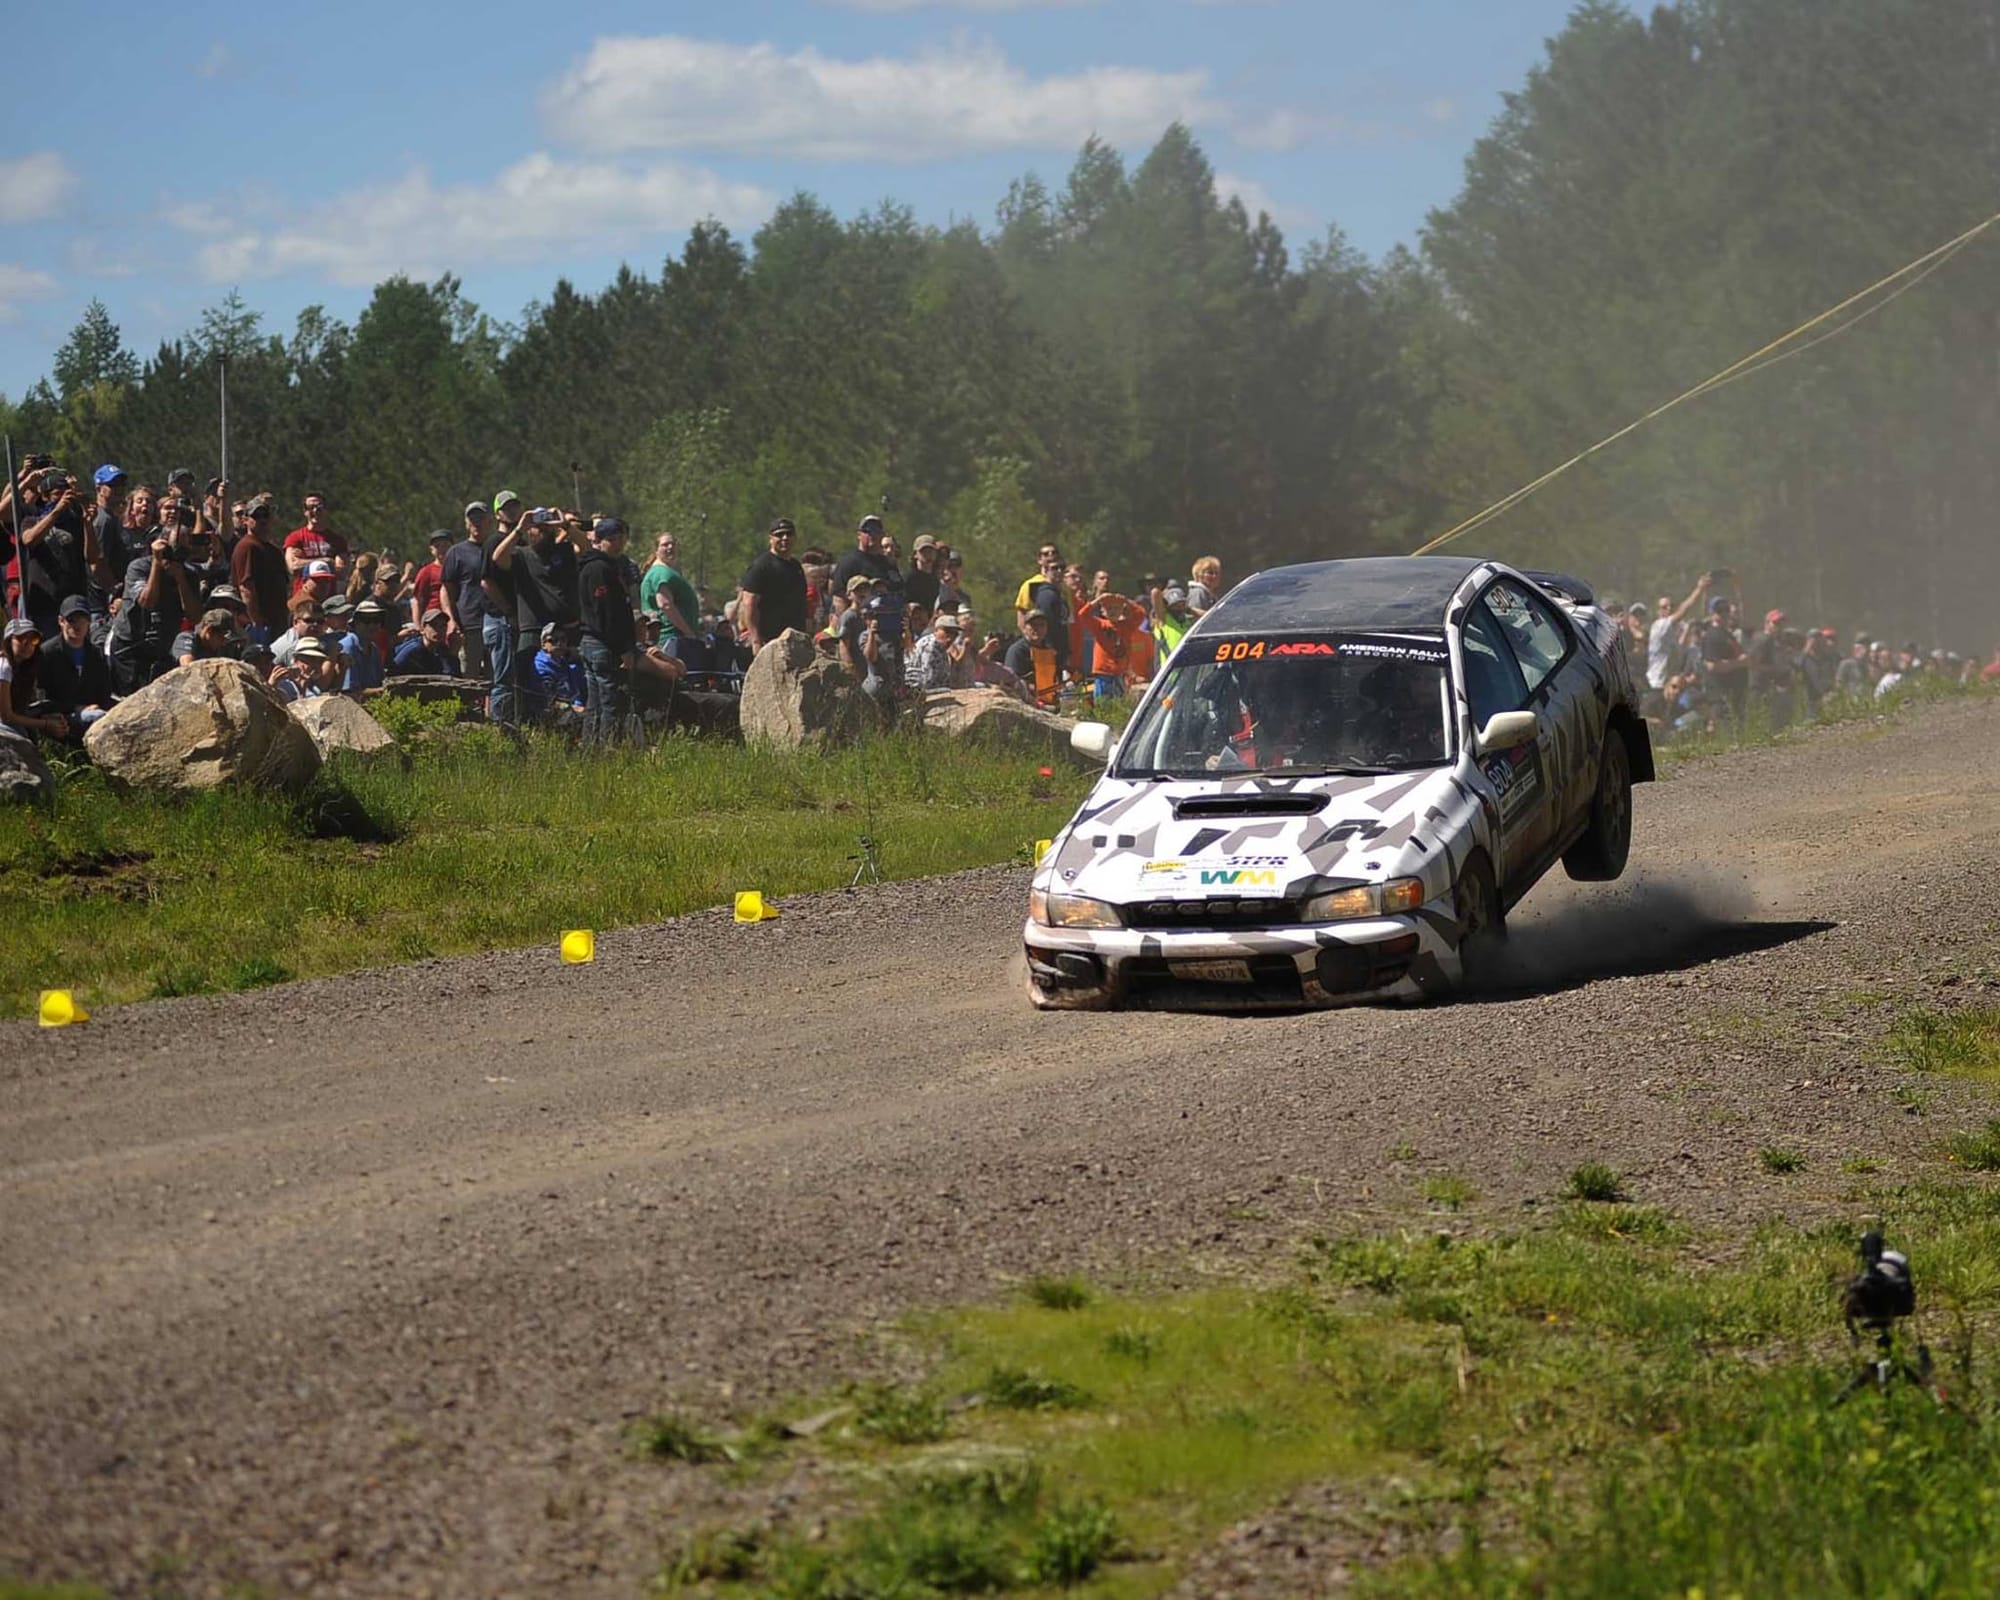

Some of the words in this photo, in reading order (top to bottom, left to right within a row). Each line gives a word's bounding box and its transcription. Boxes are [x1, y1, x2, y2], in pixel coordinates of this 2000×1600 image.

[1215, 641, 1265, 661] 904
[1269, 643, 1335, 655] ARA
[1338, 644, 1406, 655] AMERICAN
[1408, 648, 1448, 658] RALLY
